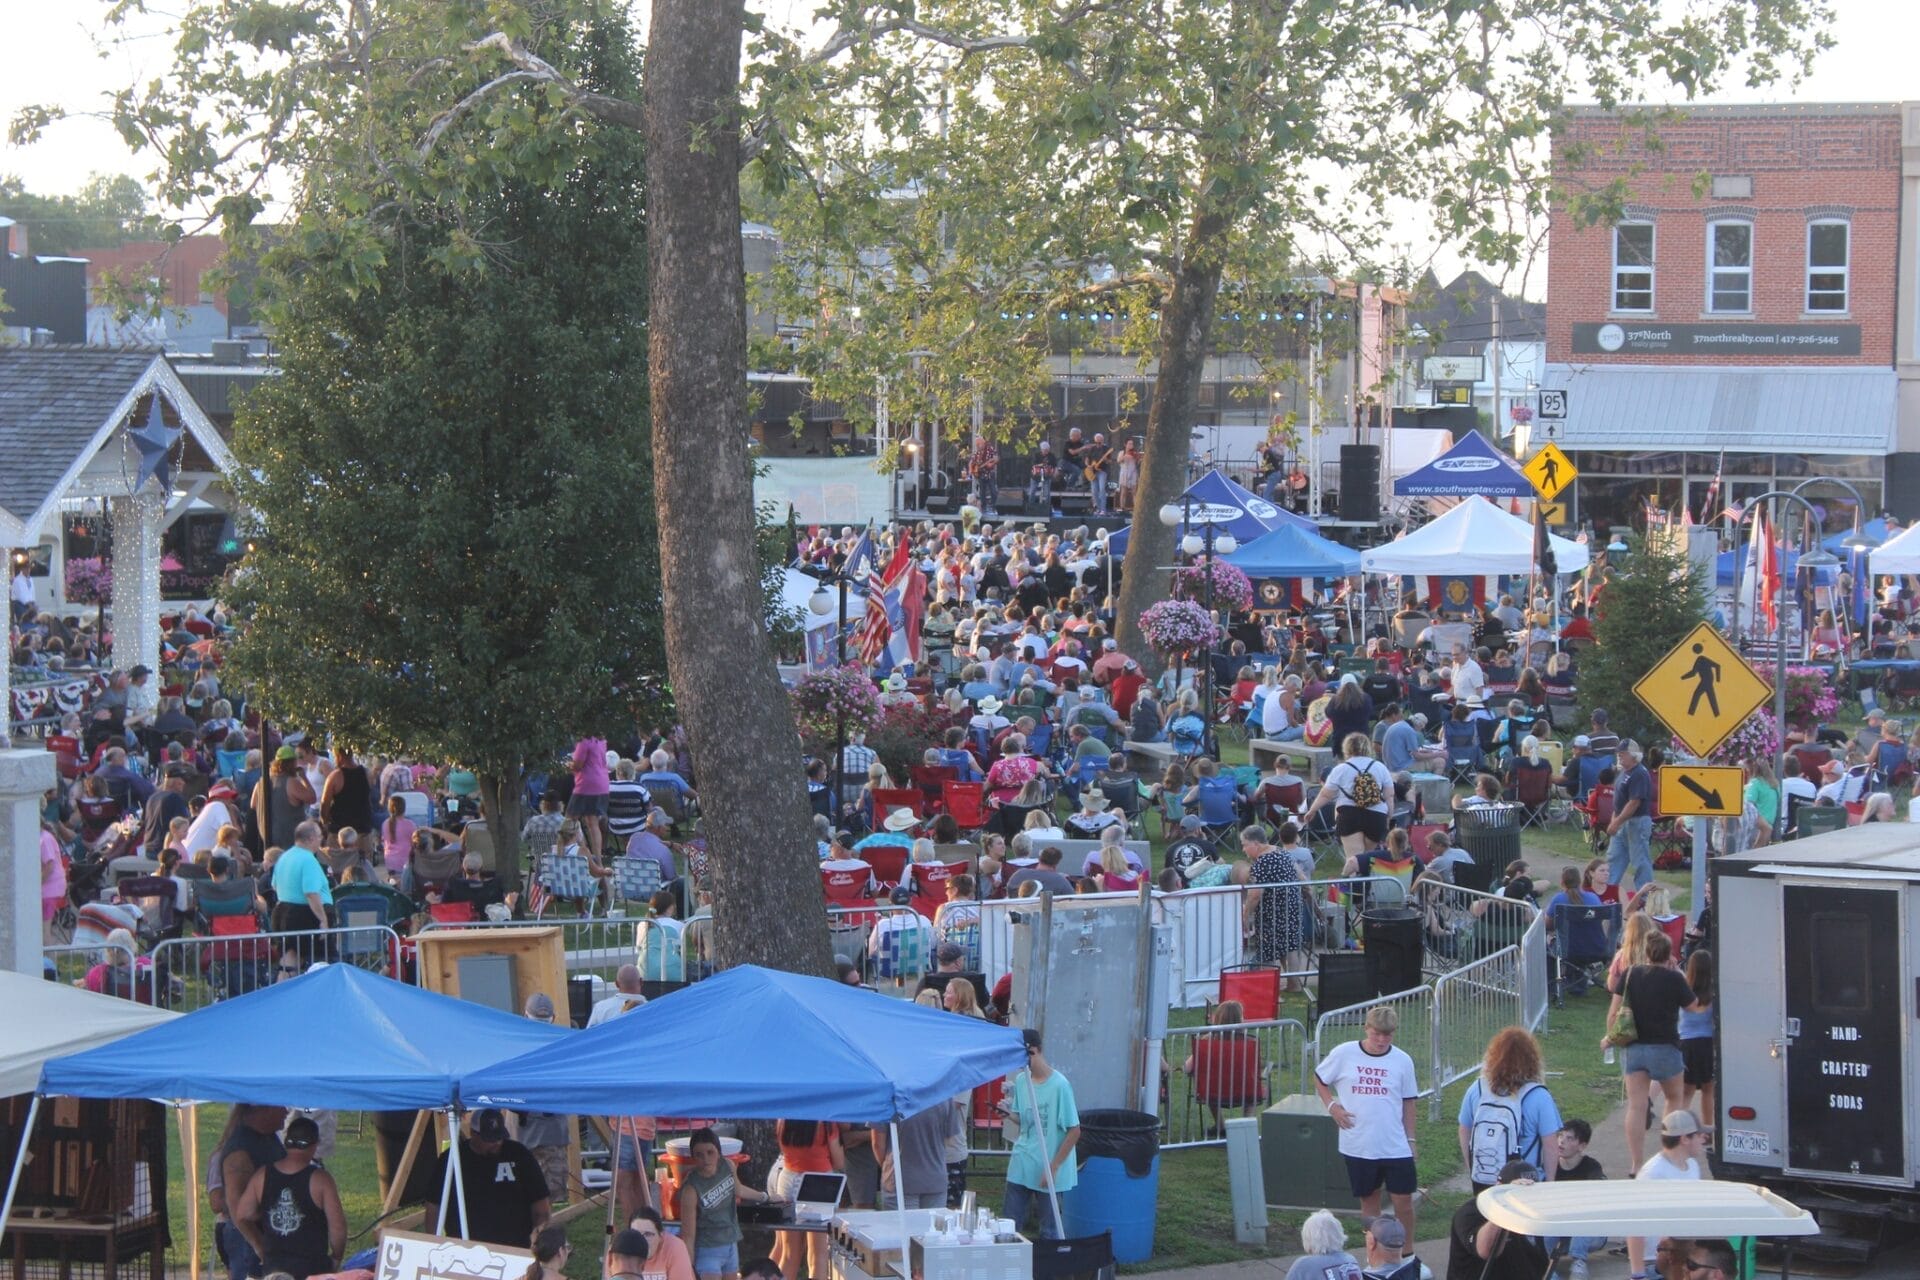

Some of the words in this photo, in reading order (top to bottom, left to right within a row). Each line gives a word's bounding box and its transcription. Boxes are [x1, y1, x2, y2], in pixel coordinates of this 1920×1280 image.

[1693, 333, 1774, 345] 37northrealty.com
[1780, 334, 1840, 345] 417-926-5445
[1544, 395, 1561, 411] 95
[1408, 484, 1517, 495] www.southwestav.com
[1357, 1066, 1388, 1077] VOTE
[1821, 1060, 1868, 1077] CRAFTED
[1359, 1076, 1381, 1086] FOR
[1351, 1086, 1388, 1095] PEDRO
[1829, 1094, 1863, 1110] SODAS
